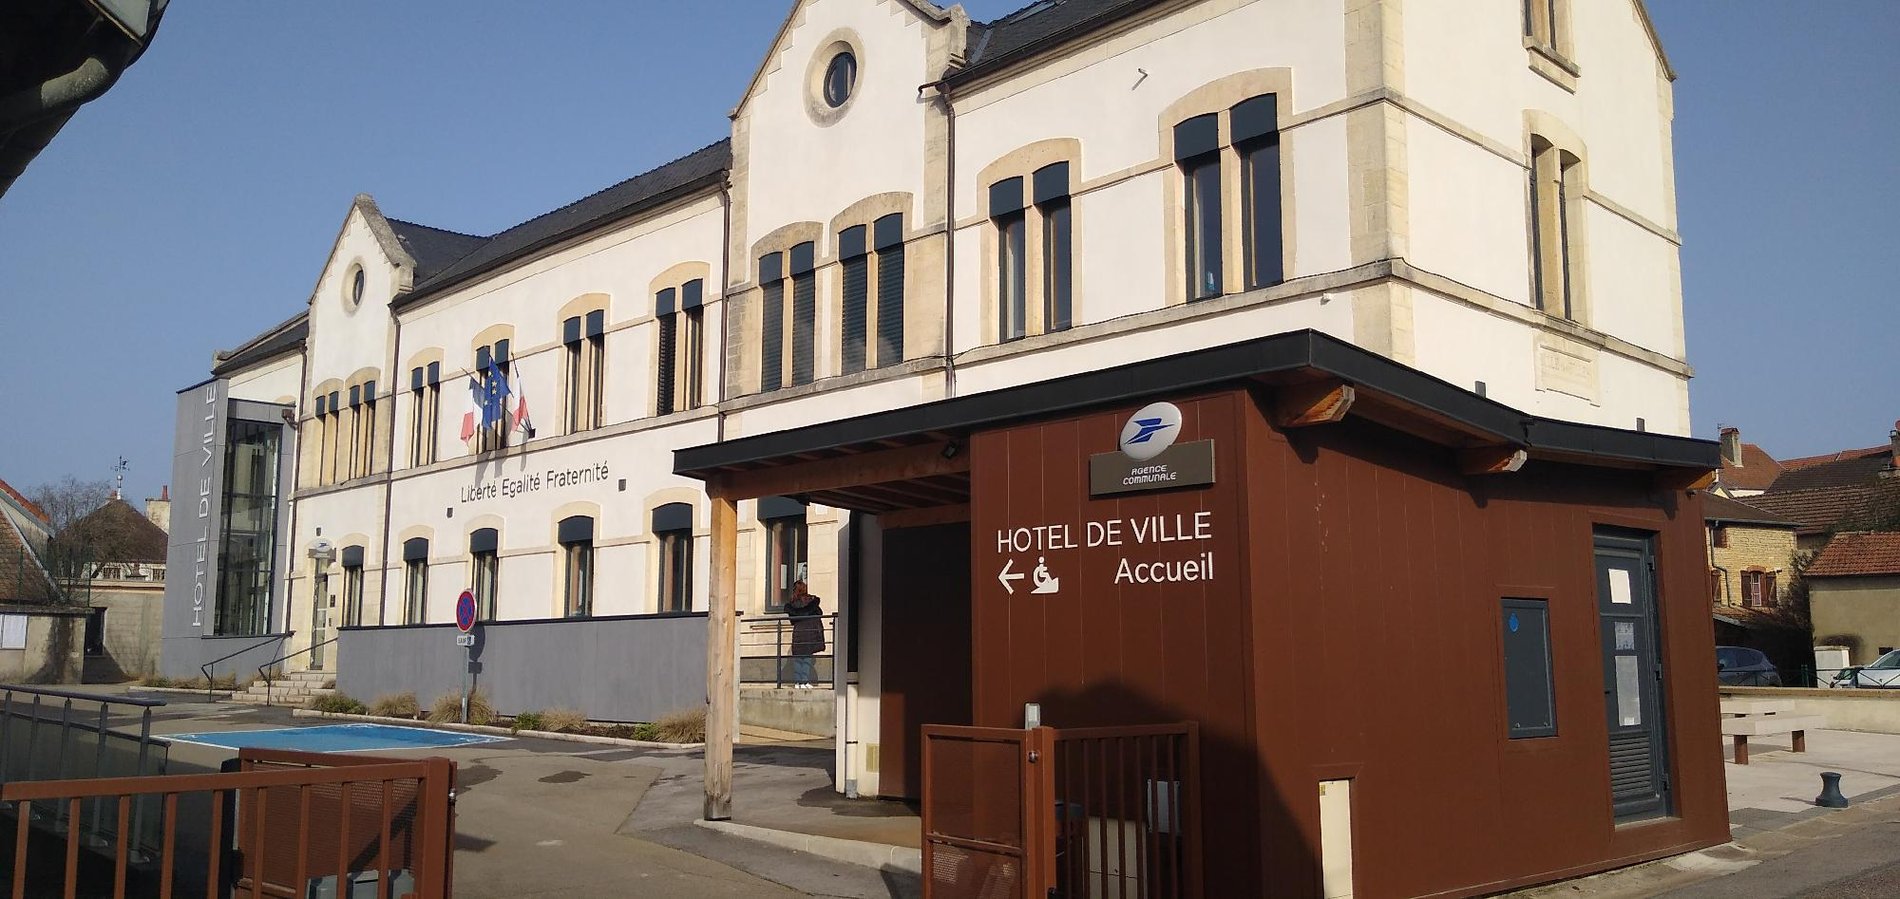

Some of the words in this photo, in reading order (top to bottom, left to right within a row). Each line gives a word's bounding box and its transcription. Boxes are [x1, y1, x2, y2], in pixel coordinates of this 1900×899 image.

[202, 383, 217, 467] VILLE
[461, 481, 498, 503] Liberté
[502, 472, 540, 498] Egalité
[546, 460, 609, 489] Fraternité
[1122, 471, 1177, 485] COMMUNALE
[1131, 464, 1168, 476] AGENCE
[198, 476, 211, 519] DE
[997, 524, 1078, 553] HOTEL
[1087, 519, 1122, 548] DE
[1130, 511, 1212, 544] VILLE
[192, 525, 207, 627] HOTEL
[1114, 551, 1214, 585] Accueil
